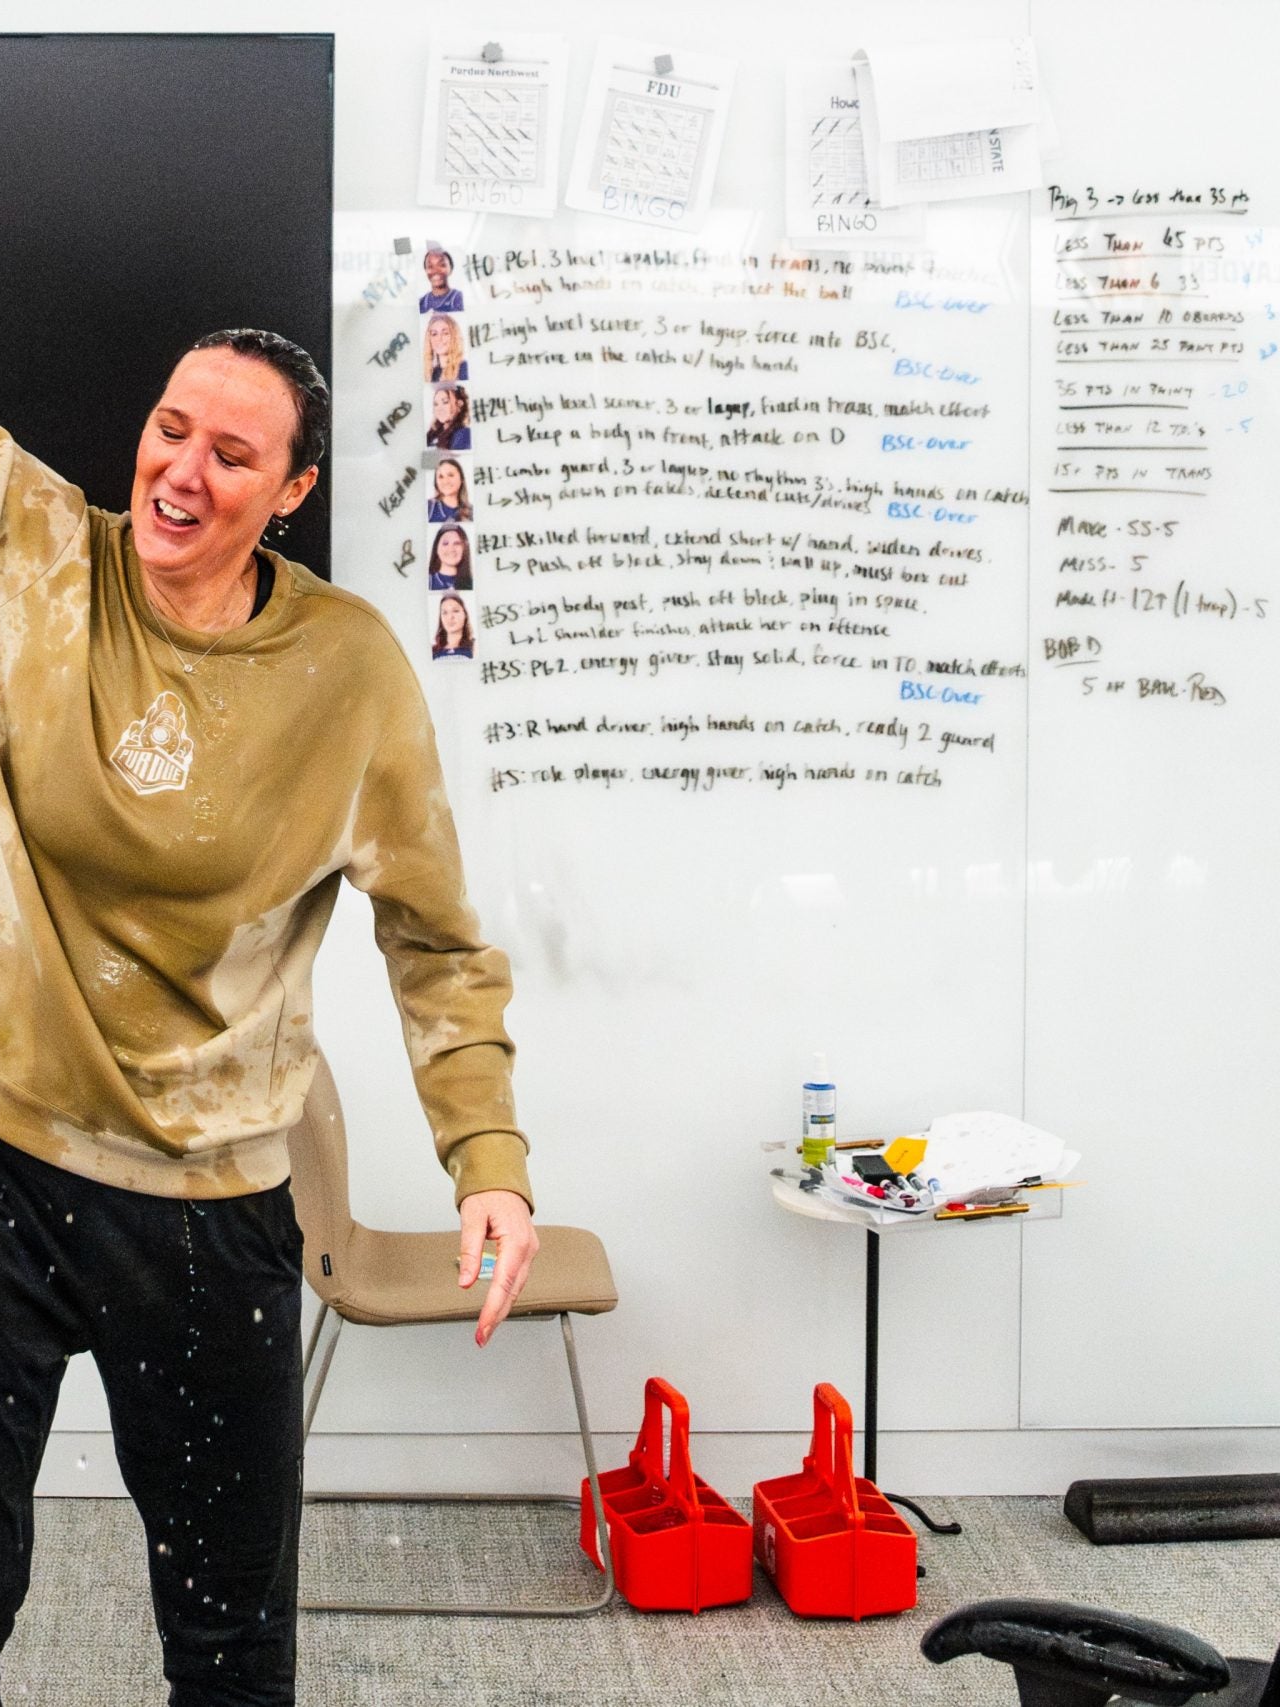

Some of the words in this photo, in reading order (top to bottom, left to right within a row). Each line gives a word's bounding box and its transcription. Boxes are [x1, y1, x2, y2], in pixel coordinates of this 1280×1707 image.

[647, 80, 681, 98] FDU
[450, 180, 523, 205] BINGO
[1210, 187, 1225, 205] 35
[603, 185, 686, 220] BINGO
[817, 214, 877, 233] BINGO
[550, 250, 561, 267] 3
[654, 315, 668, 335] 3
[601, 345, 624, 363] the
[666, 400, 678, 415] 3
[570, 429, 581, 440] a
[831, 427, 846, 445] D
[622, 459, 634, 475] 3
[1165, 466, 1212, 481] TRANS
[1130, 555, 1149, 571] 5
[1082, 676, 1098, 696] 5
[526, 720, 541, 739] R
[918, 723, 932, 742] 2
[118, 748, 183, 782] PURDUE
